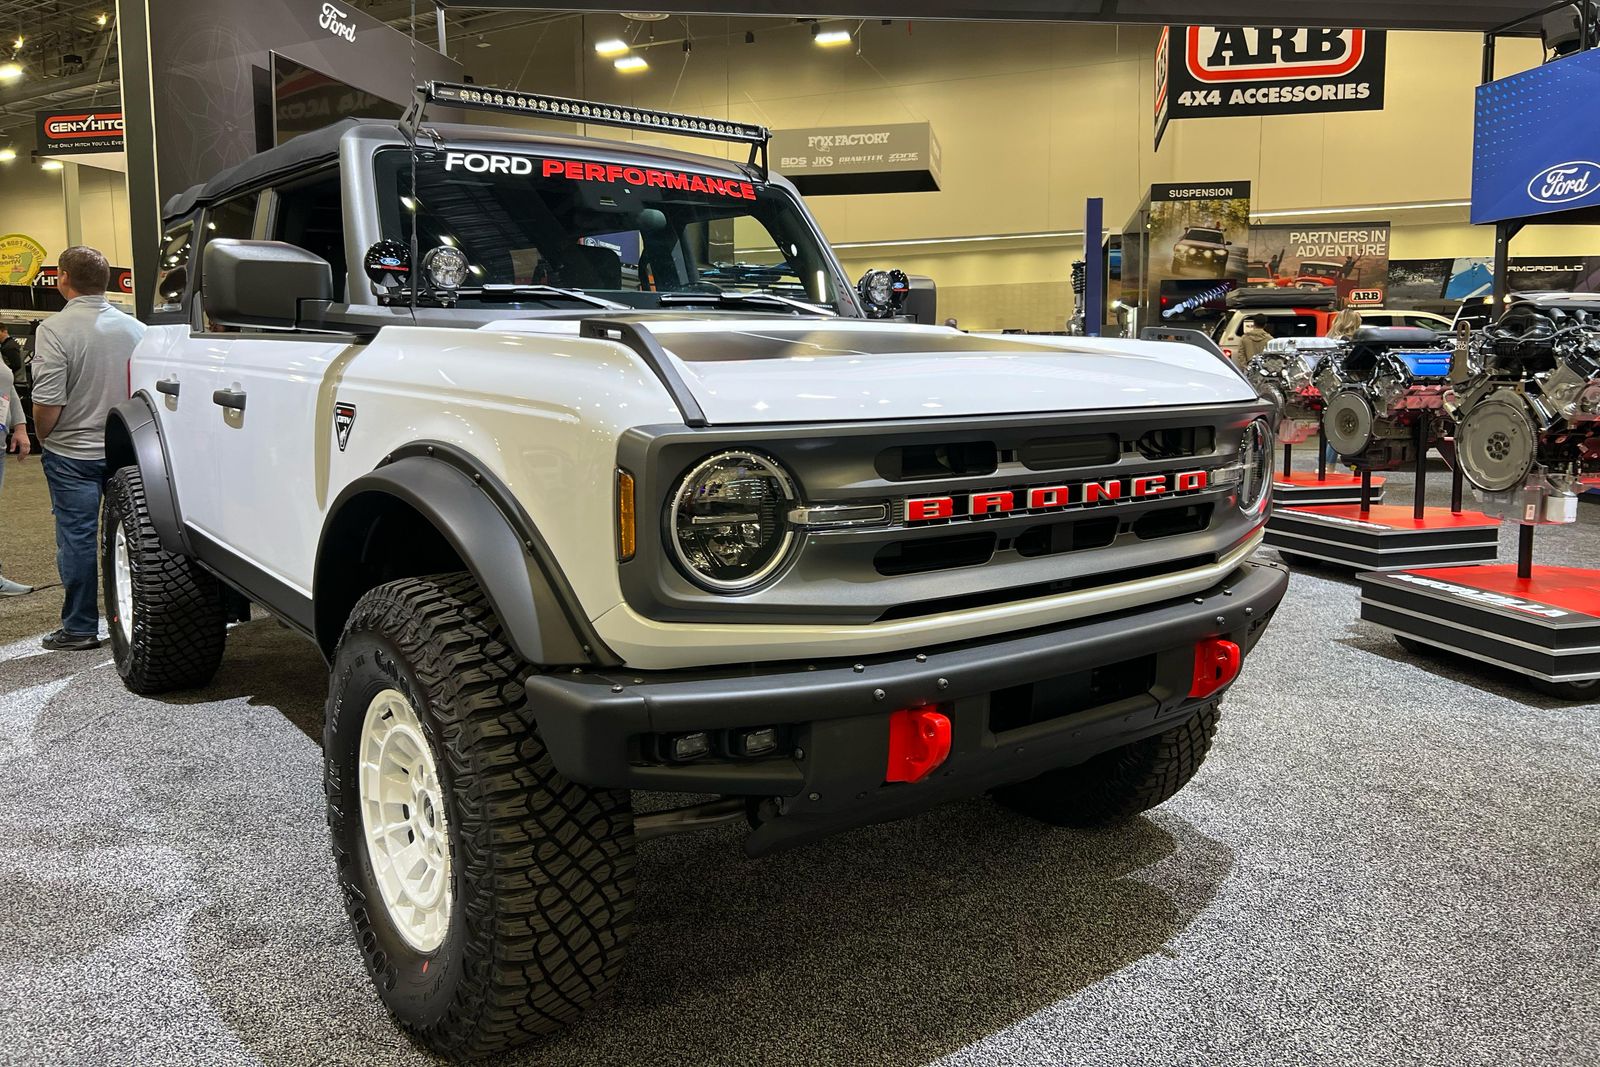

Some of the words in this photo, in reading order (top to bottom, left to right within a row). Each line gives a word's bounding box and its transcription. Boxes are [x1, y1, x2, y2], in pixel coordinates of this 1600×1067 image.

[319, 3, 356, 42] Ford
[1207, 26, 1347, 66] ARB
[1177, 90, 1222, 107] 4X4
[1229, 83, 1370, 105] ACCESSORIES
[91, 119, 124, 131] HITC
[808, 135, 833, 151] FOX
[835, 132, 890, 146] FACTORY
[781, 157, 807, 165] BDS
[812, 156, 833, 166] JKS
[445, 152, 533, 176] FORD
[542, 158, 757, 201] PERFORMANCE
[1541, 167, 1591, 198] Ford
[1169, 187, 1233, 199] SUSPENSION
[1289, 230, 1368, 244] PARTNERS
[1371, 230, 1386, 243] IN
[1296, 243, 1386, 258] ADVENTURE
[1353, 291, 1379, 301] ARB
[903, 470, 1207, 523] BRONCO
